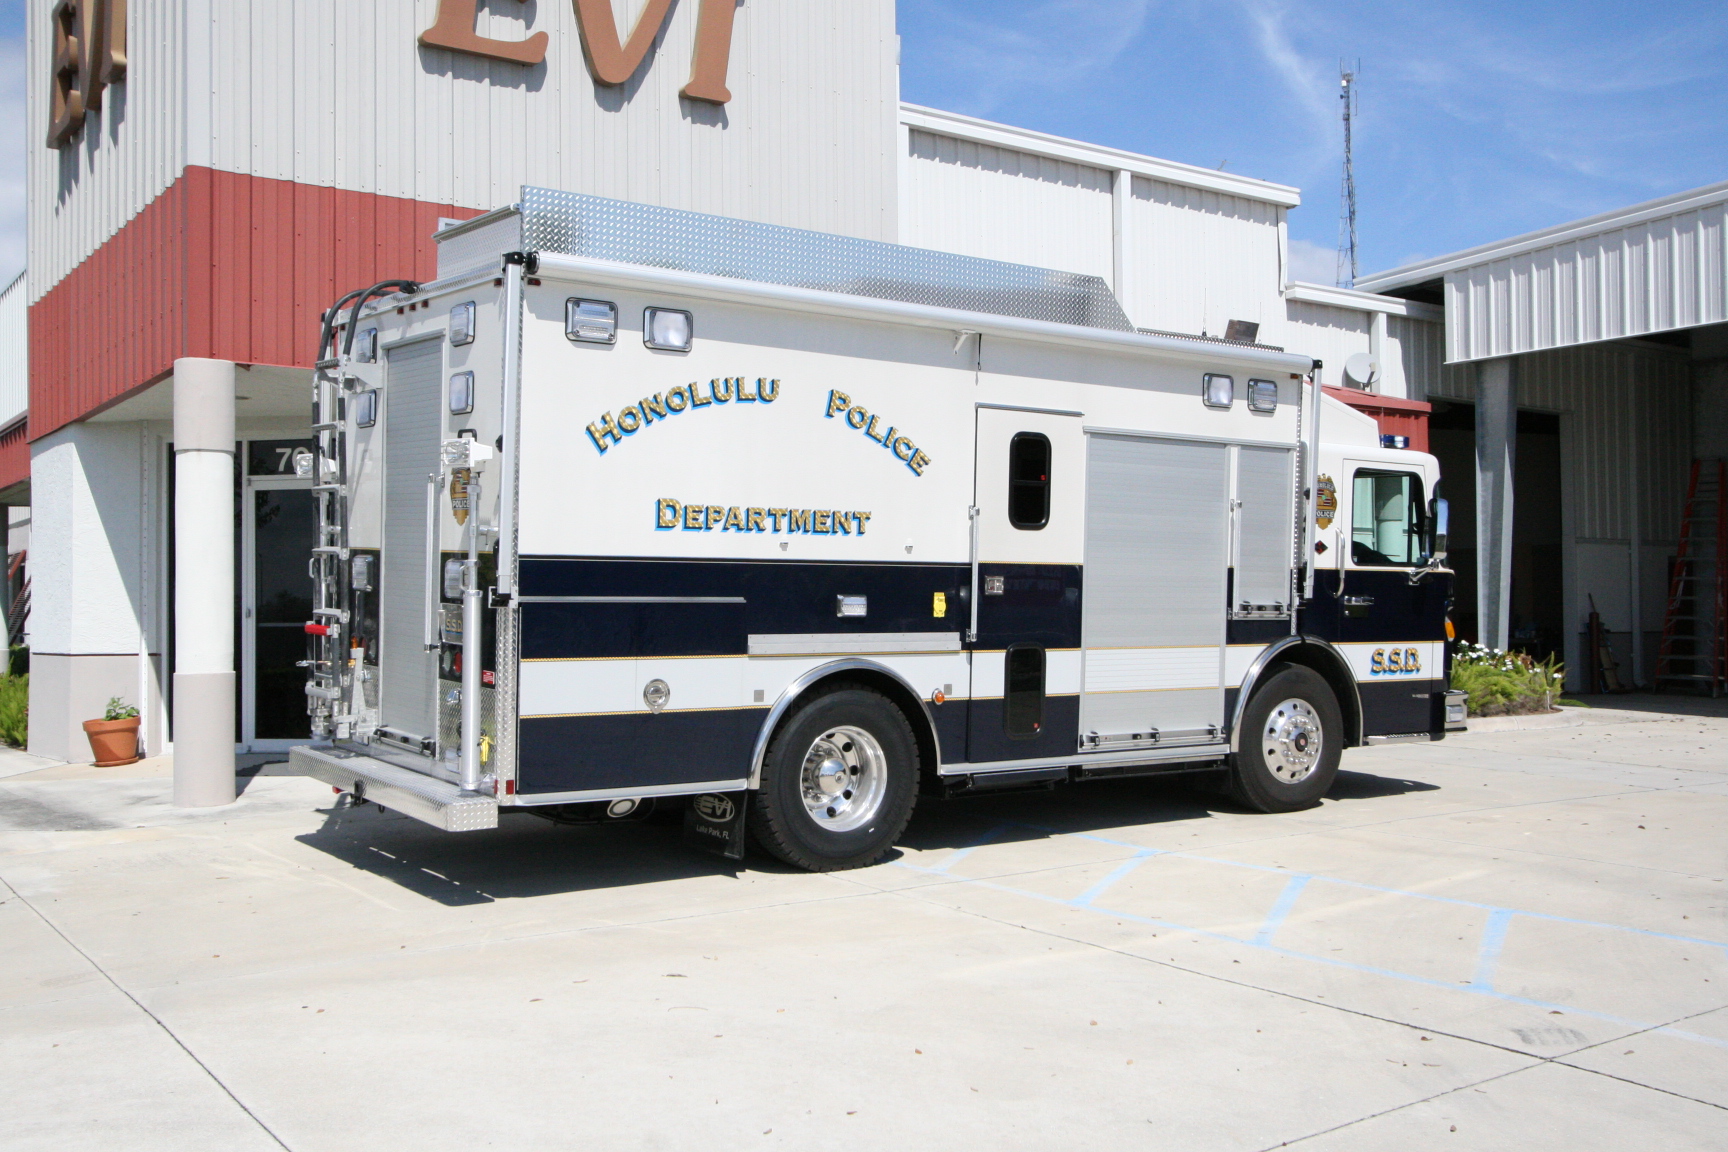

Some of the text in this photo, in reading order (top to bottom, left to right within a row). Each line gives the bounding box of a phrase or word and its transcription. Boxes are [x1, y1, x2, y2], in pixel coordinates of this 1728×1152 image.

[585, 376, 932, 477] HONOLULU POLICE
[654, 497, 872, 536] DEPARTMENT
[1316, 510, 1335, 518] OLICE
[1369, 647, 1422, 677] S.S.D.
